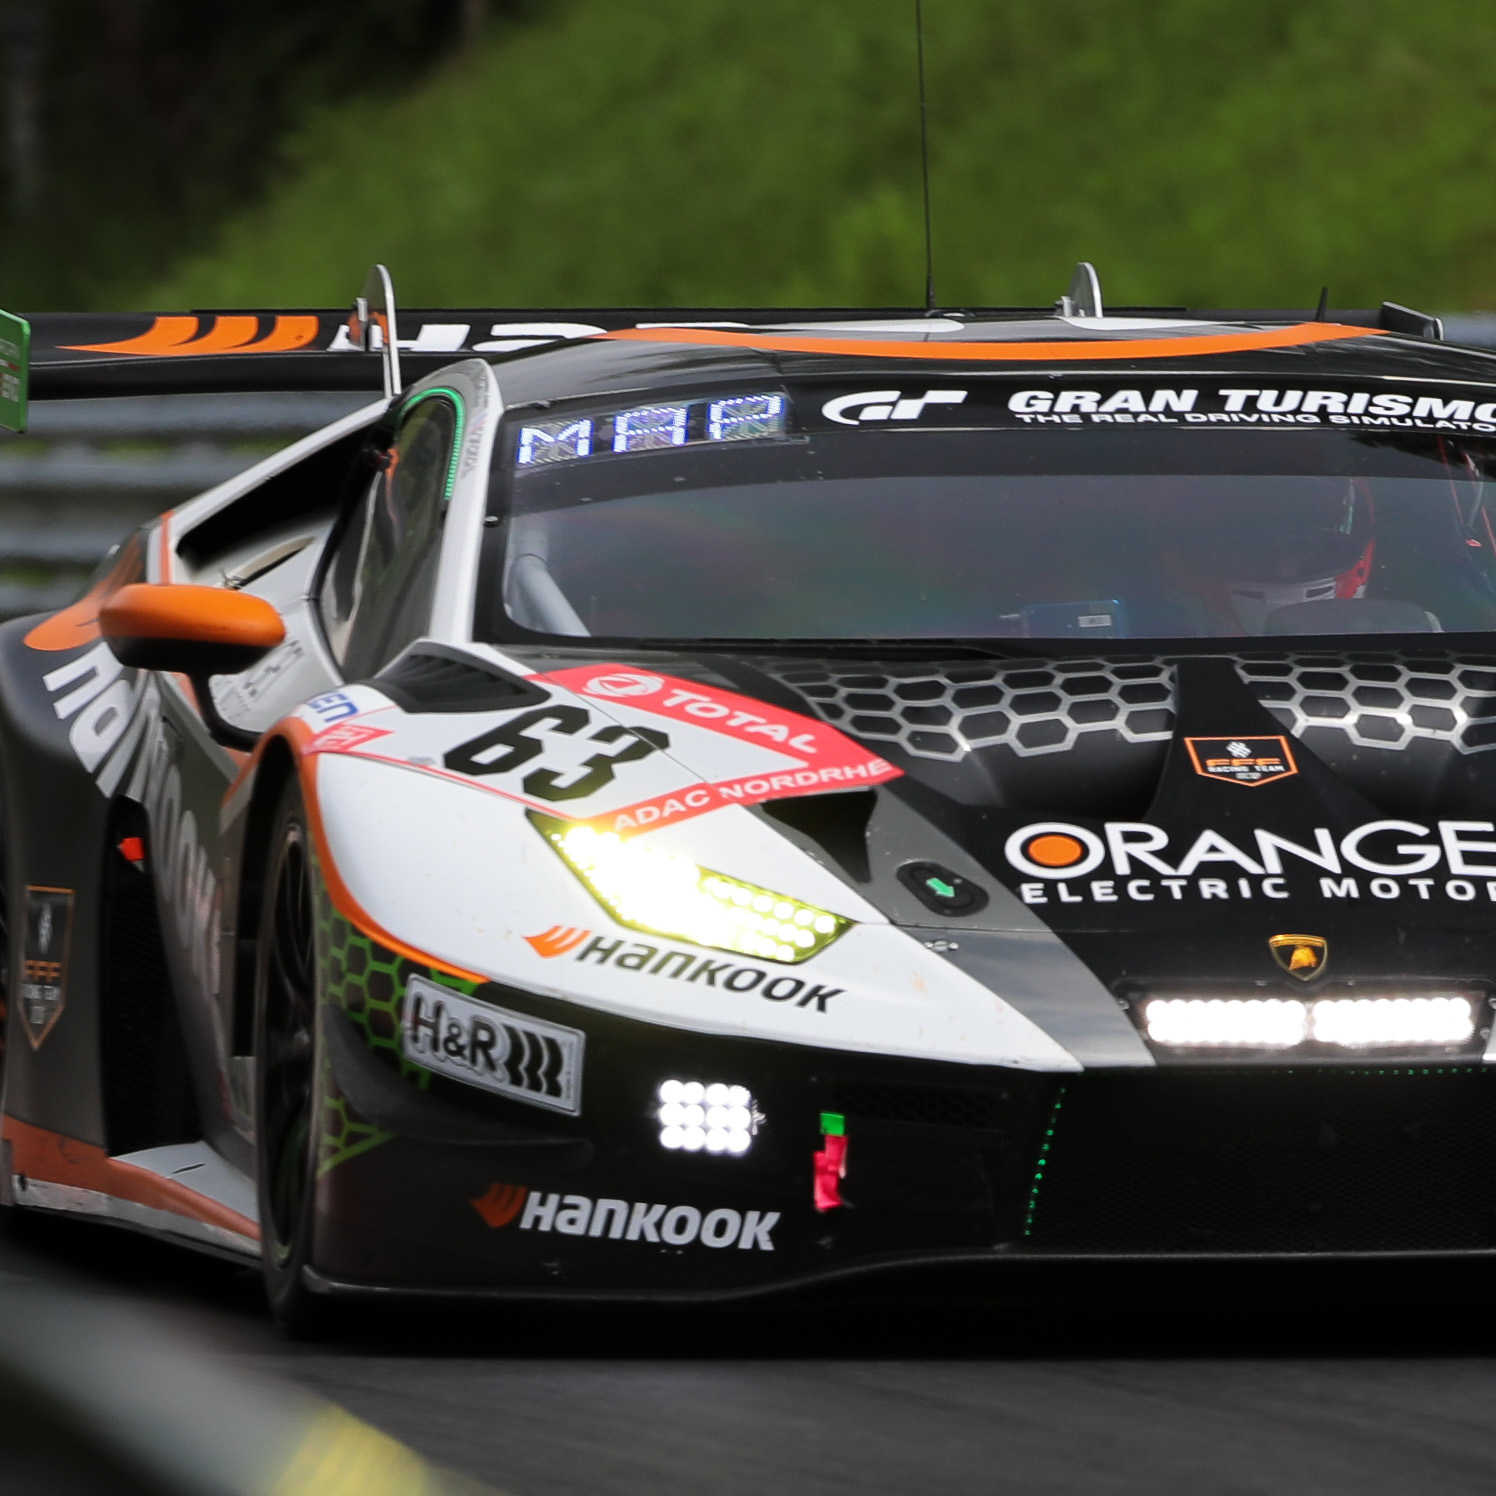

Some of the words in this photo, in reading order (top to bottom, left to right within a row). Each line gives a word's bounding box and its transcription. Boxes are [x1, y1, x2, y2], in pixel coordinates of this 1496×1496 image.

[1007, 389, 1200, 413] GRAN
[1023, 413, 1082, 423] THE
[1091, 413, 1178, 423] REAL
[1185, 412, 1321, 424] DRIVING
[517, 394, 785, 465] MAP
[663, 689, 819, 754] TOTAL
[443, 704, 670, 801] 63
[612, 790, 710, 833] ADAC
[1021, 877, 1291, 905] ELECTRIC
[411, 996, 497, 1073] H&R
